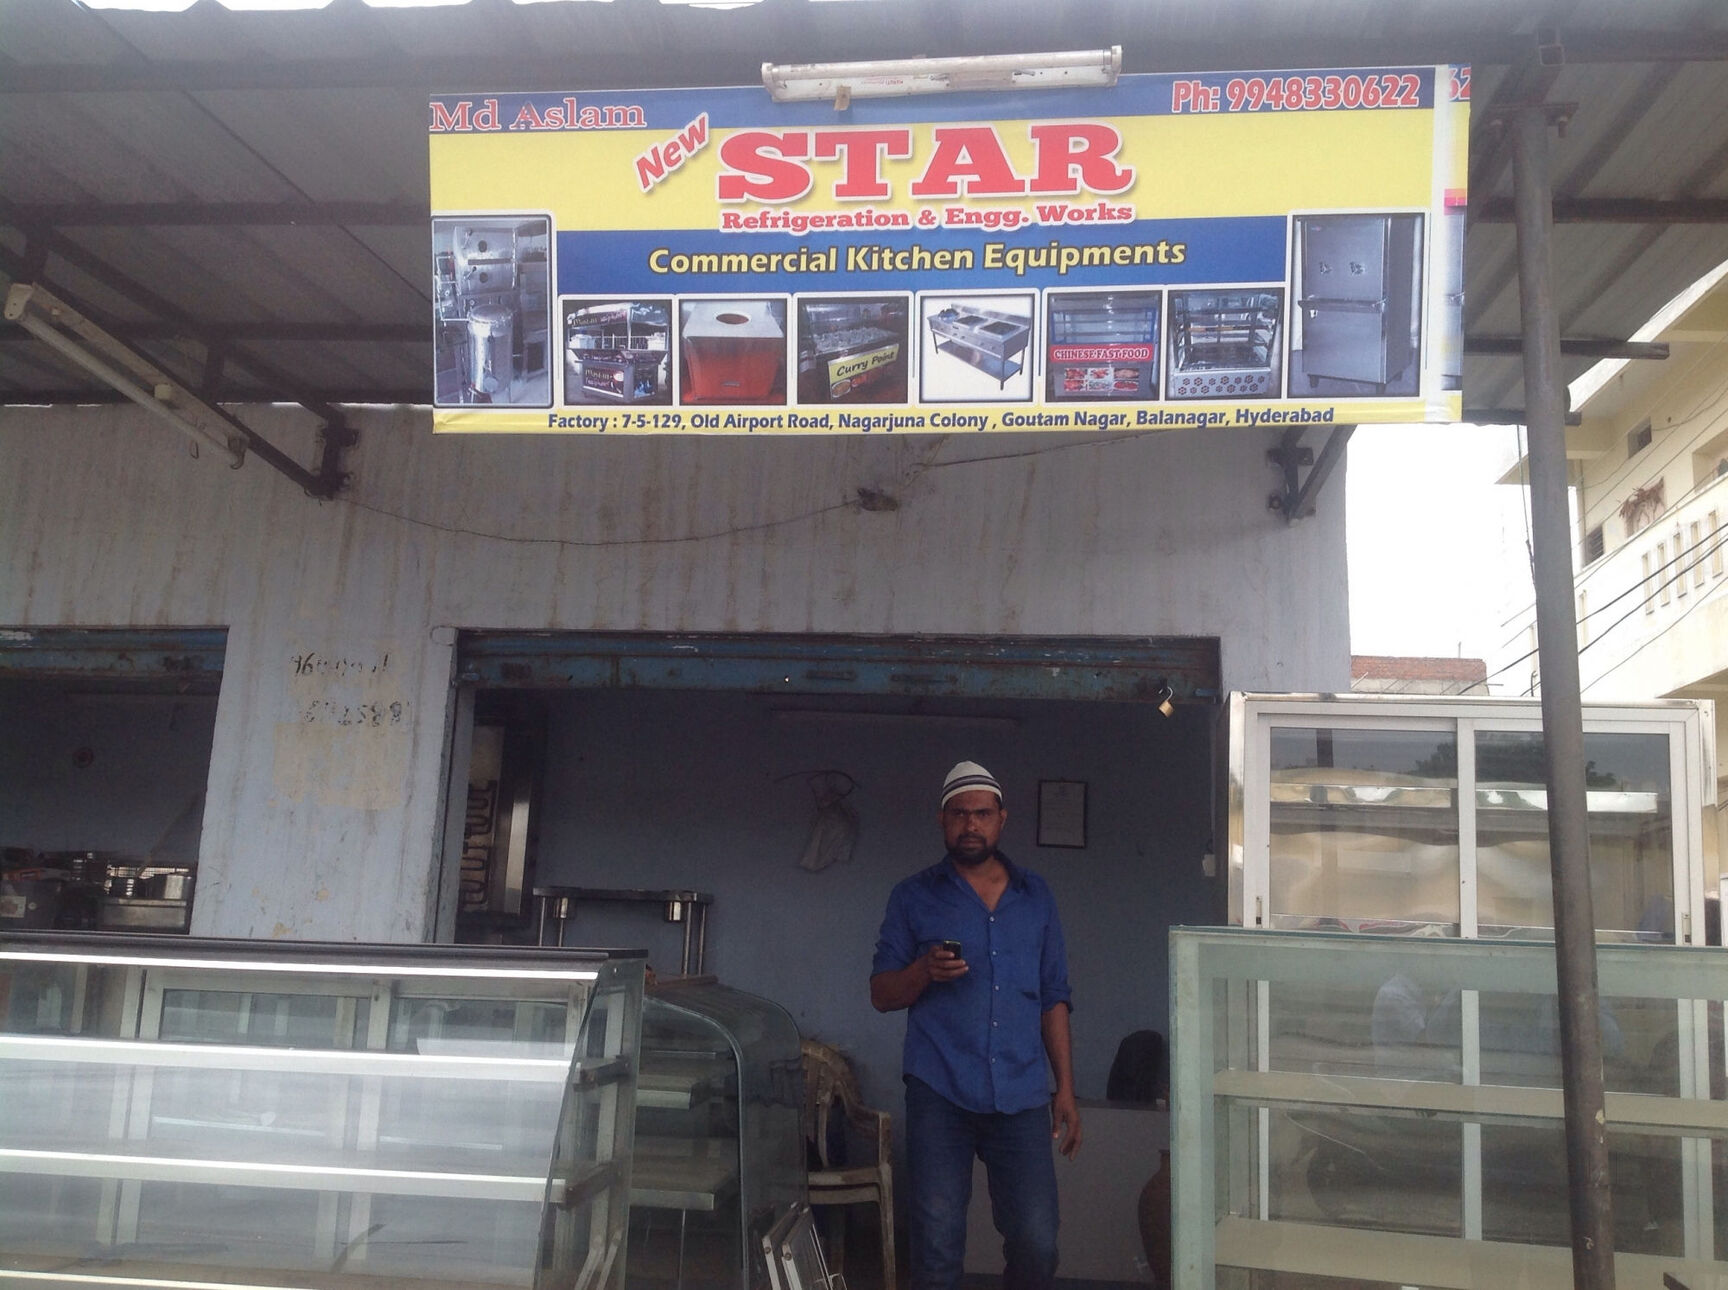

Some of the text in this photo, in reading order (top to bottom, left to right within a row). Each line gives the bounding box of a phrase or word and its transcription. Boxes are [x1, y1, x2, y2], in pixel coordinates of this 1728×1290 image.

[1172, 74, 1421, 113] Ph: 9948330622
[429, 97, 648, 132] Md Aslam
[635, 113, 708, 191] New
[718, 124, 1134, 201] STAR
[722, 202, 1133, 232] Refrigeration & Engg. Works
[648, 240, 1187, 276] Commercial Kitchen Equipments
[836, 360, 869, 377] Curry
[1055, 347, 1149, 360] CHINESE FAST FOOD
[547, 412, 609, 432] Factory
[621, 412, 687, 431] 7-5-129,
[690, 412, 720, 429] Old
[723, 412, 784, 433] Airport
[787, 412, 834, 431] Road,
[838, 412, 926, 433] Nagarjuna
[929, 411, 989, 431] Colony
[1001, 410, 1069, 427] Goutam
[1073, 410, 1132, 430] Nagar,
[1136, 408, 1231, 429] Balanagar,
[1235, 406, 1335, 428] Hyderabad
